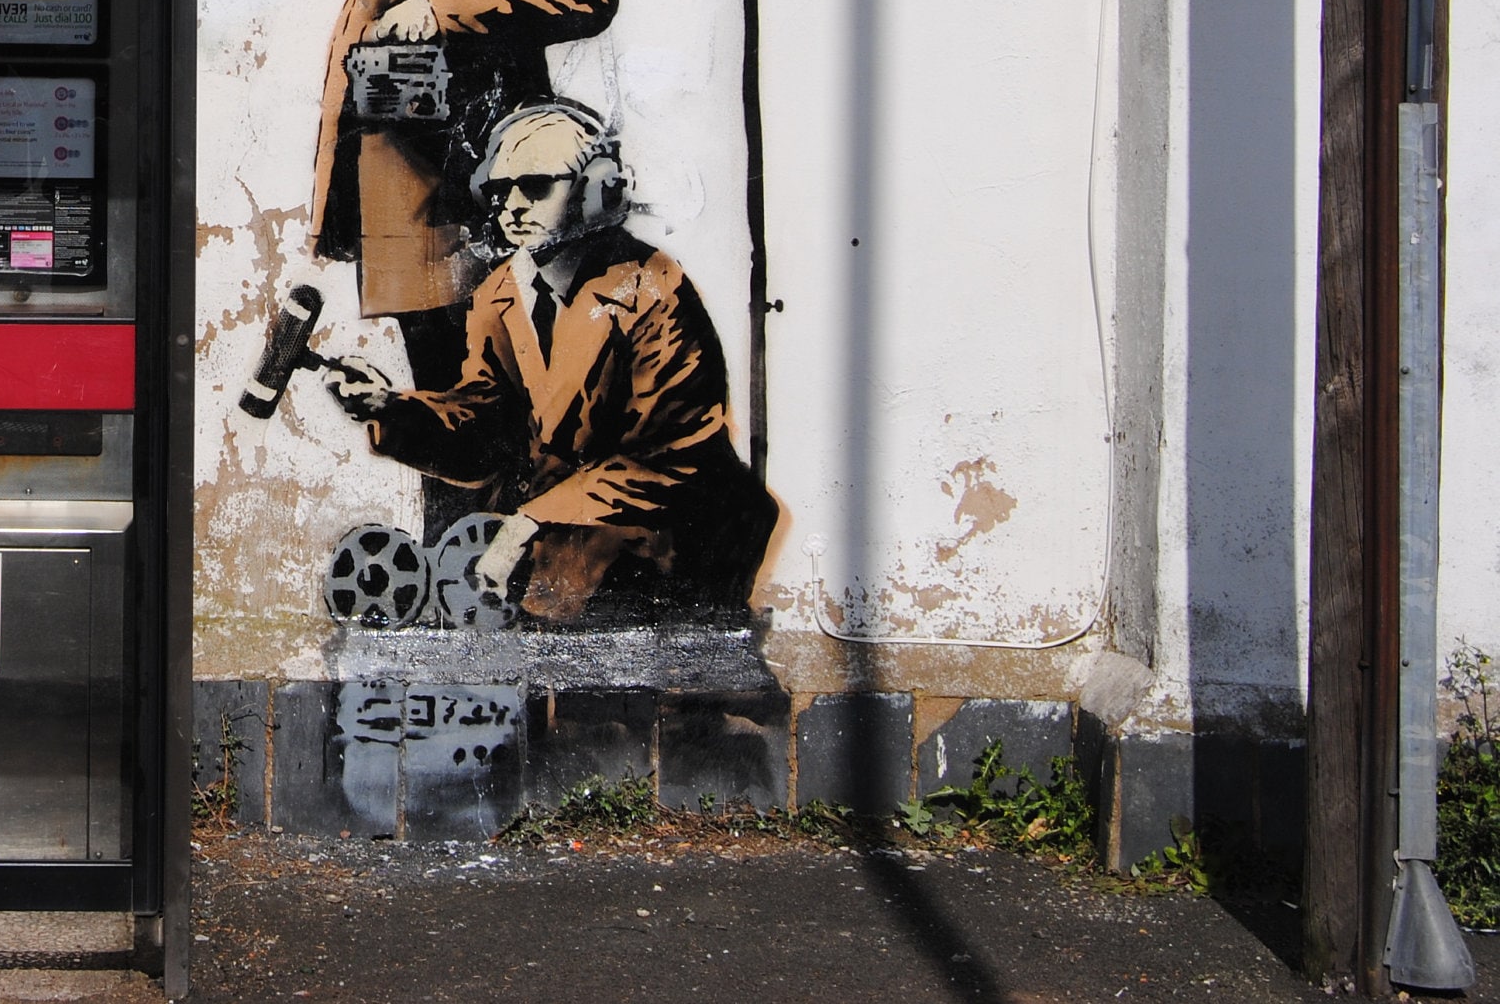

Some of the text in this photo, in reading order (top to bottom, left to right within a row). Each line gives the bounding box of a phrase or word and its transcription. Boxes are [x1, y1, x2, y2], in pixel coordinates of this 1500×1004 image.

[34, 4, 44, 12] No
[47, 4, 62, 12] cash
[72, 4, 92, 12] card?
[4, 15, 27, 23] CALLS
[34, 13, 92, 24] Just dial 100
